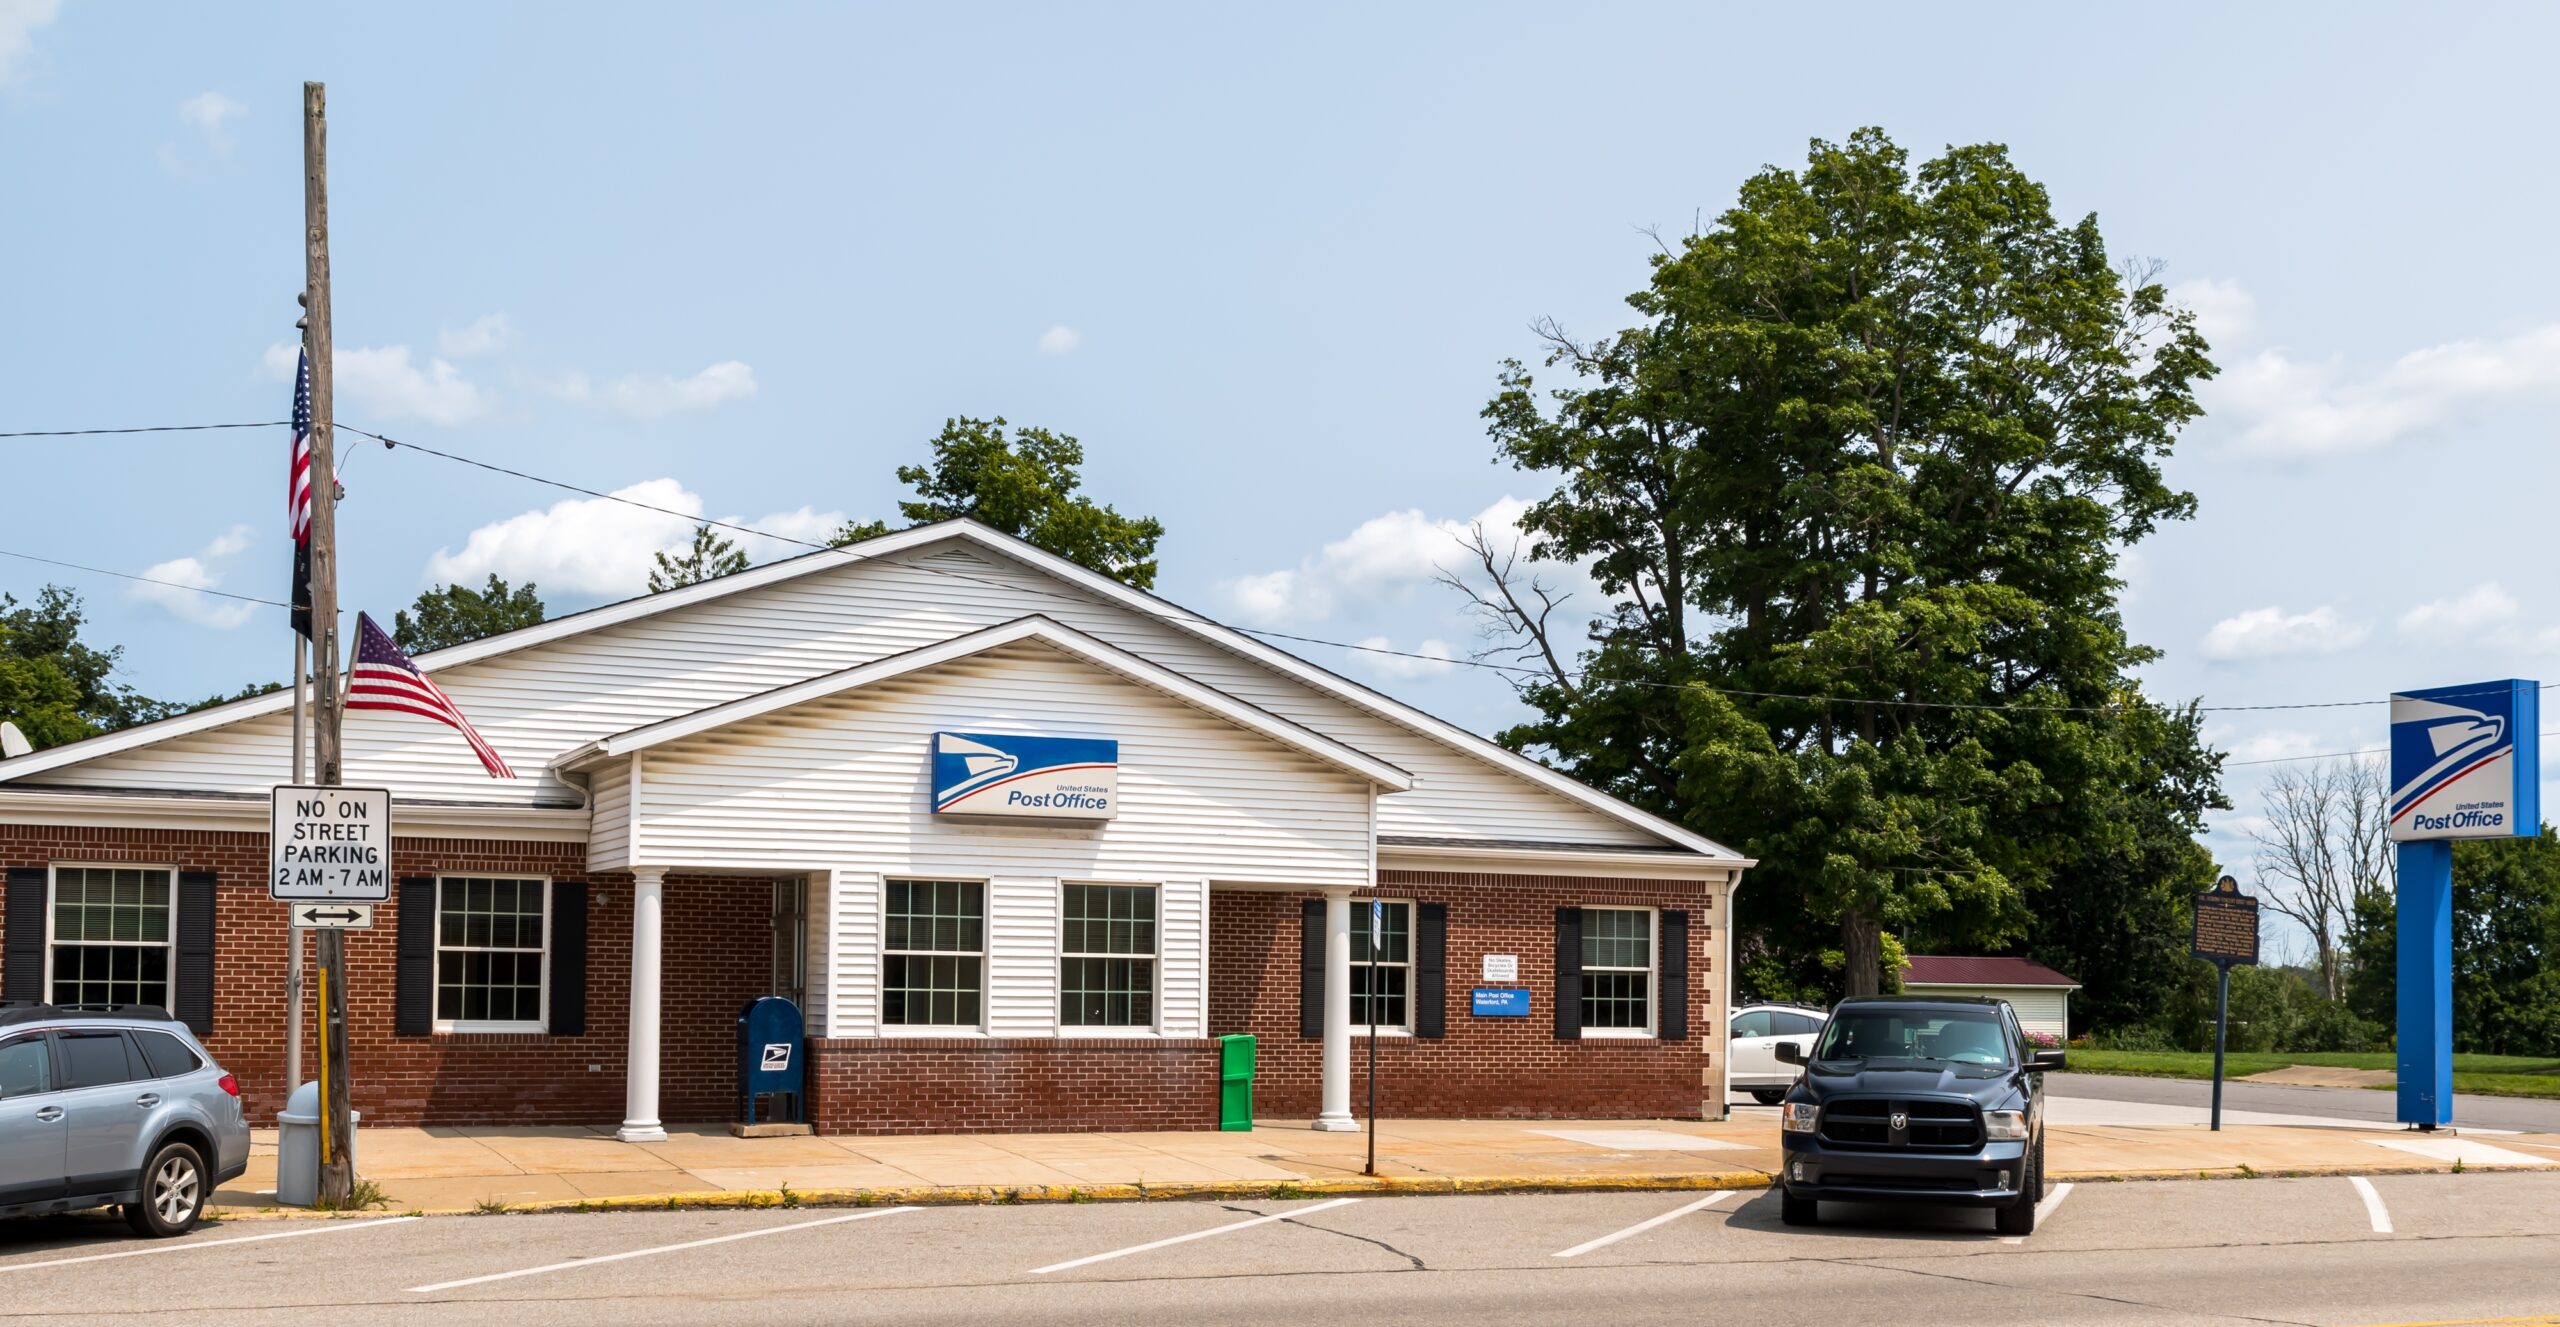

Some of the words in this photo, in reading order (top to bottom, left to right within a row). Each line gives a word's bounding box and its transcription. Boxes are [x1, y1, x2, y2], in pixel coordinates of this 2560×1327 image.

[1056, 784, 1083, 792] United
[1083, 785, 1108, 793] States
[296, 800, 325, 818] NO
[339, 801, 367, 819] ON
[1008, 790, 1051, 808] Post
[1052, 792, 1107, 810] Office
[2456, 802, 2480, 811] United
[2480, 801, 2504, 809] States
[2413, 814, 2452, 830] Post
[2453, 811, 2503, 828] Office
[294, 822, 370, 842] STREET
[284, 845, 378, 865] PARKING
[279, 868, 290, 886] 2
[296, 868, 323, 886] AM
[340, 869, 351, 886] 7
[356, 869, 382, 887] AM
